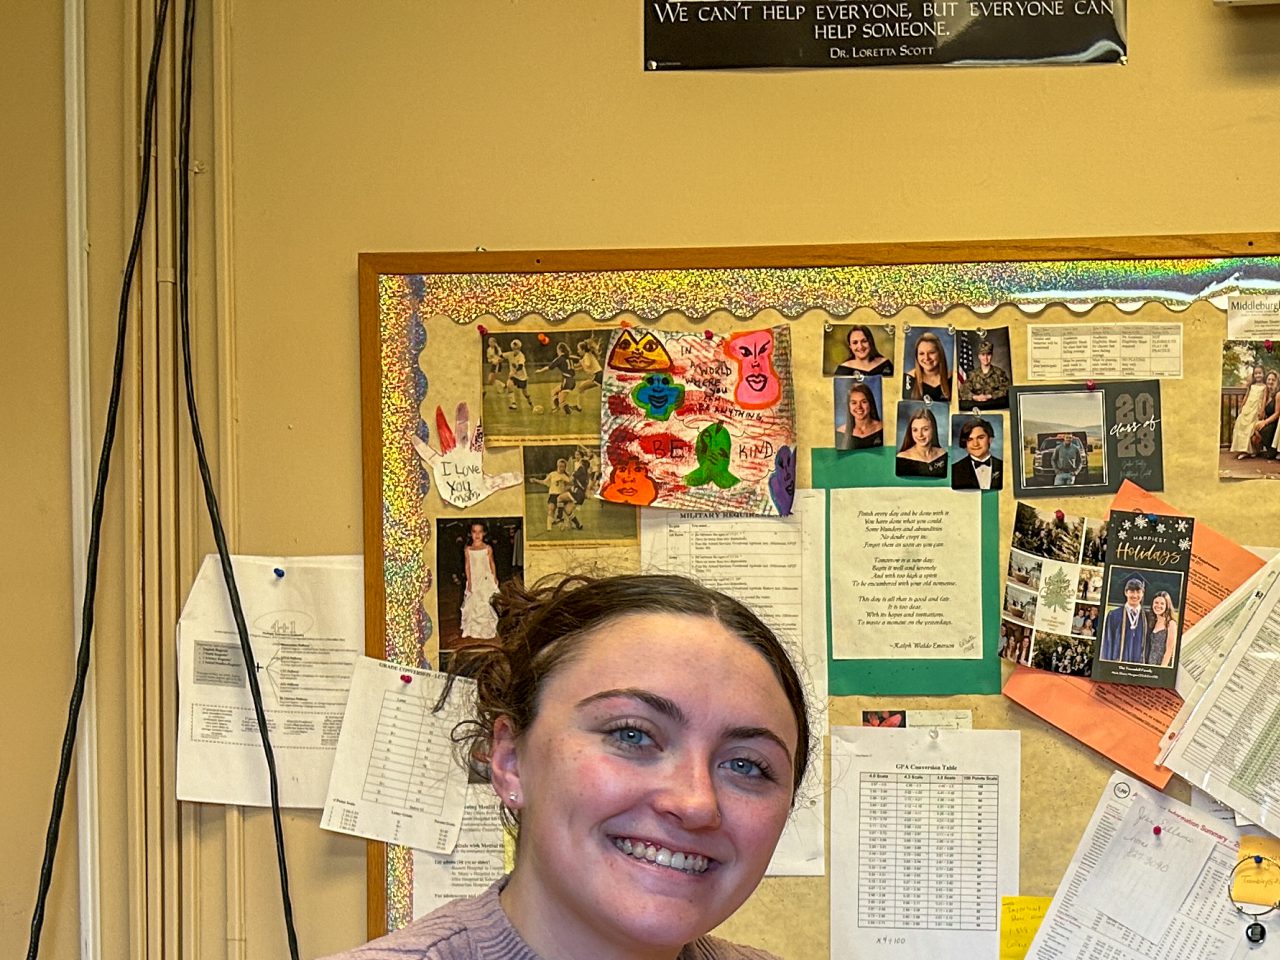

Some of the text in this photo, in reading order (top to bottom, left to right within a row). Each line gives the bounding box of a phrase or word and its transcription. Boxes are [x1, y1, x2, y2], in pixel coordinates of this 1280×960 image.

[698, 2, 752, 21] CAN'T
[763, 5, 806, 20] HELP
[816, 3, 912, 20] EVERYONE,
[923, 2, 958, 17] BUT
[970, 1, 1064, 17] EVERYONE
[1074, 0, 1114, 15] CAN
[815, 21, 950, 39] HELP SOMEONE.
[1116, 542, 1181, 566] Holidays
[1200, 825, 1228, 842] Summary
